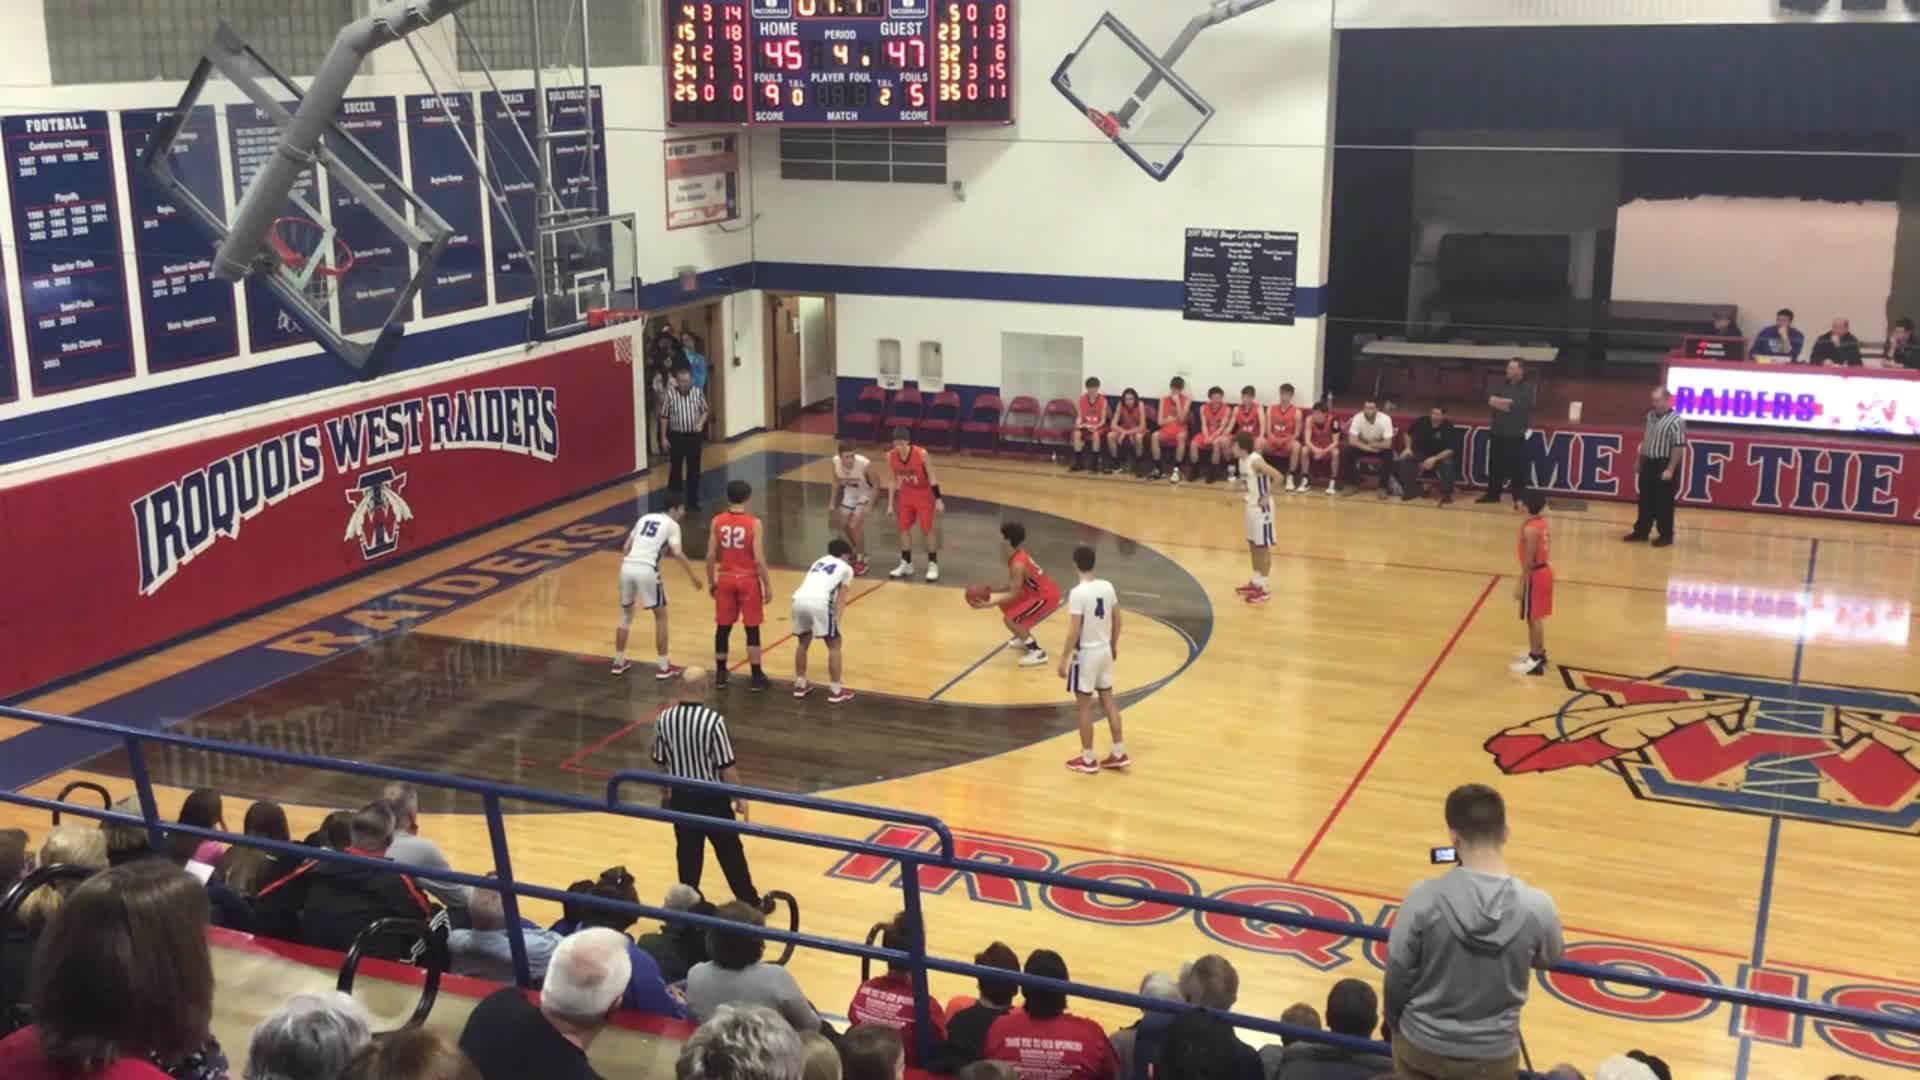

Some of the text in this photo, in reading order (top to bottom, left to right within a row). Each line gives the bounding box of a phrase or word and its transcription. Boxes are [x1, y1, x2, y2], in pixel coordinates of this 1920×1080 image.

[683, 4, 742, 21] 4 3 14
[949, 4, 1006, 21] 5 0 0
[678, 24, 742, 41] 15 1 18
[760, 22, 799, 36] HOME
[824, 30, 857, 40] PERIOD
[880, 22, 923, 36] GUEST
[938, 23, 1006, 41] 23 1 13
[673, 44, 743, 62] 21 2 3
[764, 40, 802, 70] 45
[833, 44, 848, 64] 4
[887, 40, 925, 67] 47
[939, 44, 1006, 61] 32 1 6
[673, 63, 743, 80] 24 1 7
[754, 73, 783, 83] FOULS
[811, 72, 872, 83] PLAYER FOUL
[900, 72, 928, 82] FOULS
[939, 63, 1006, 81] 33 3 15
[674, 84, 744, 101] 25 0 0
[765, 84, 780, 106] 9
[792, 88, 804, 106] 0
[879, 88, 891, 106] 2
[910, 83, 925, 106] 5
[939, 83, 1006, 101] 35 0 11
[344, 101, 376, 114] SOCCER
[827, 111, 858, 120] MATCH
[900, 111, 929, 120] SCORE
[25, 117, 87, 133] FOOTBALL
[755, 112, 784, 121] SCORE
[1675, 386, 1816, 422] RAIDERS
[1748, 443, 1904, 518] THE
[131, 423, 324, 596] IROQUOIS
[325, 398, 425, 474] WEST
[428, 387, 560, 462] RAIDERS
[640, 520, 661, 537] 15
[720, 525, 746, 548] 32
[811, 562, 838, 576] 24
[264, 524, 626, 657] RAIDERS
[1094, 597, 1105, 620] 4
[824, 823, 1920, 1069] IROQOIS
